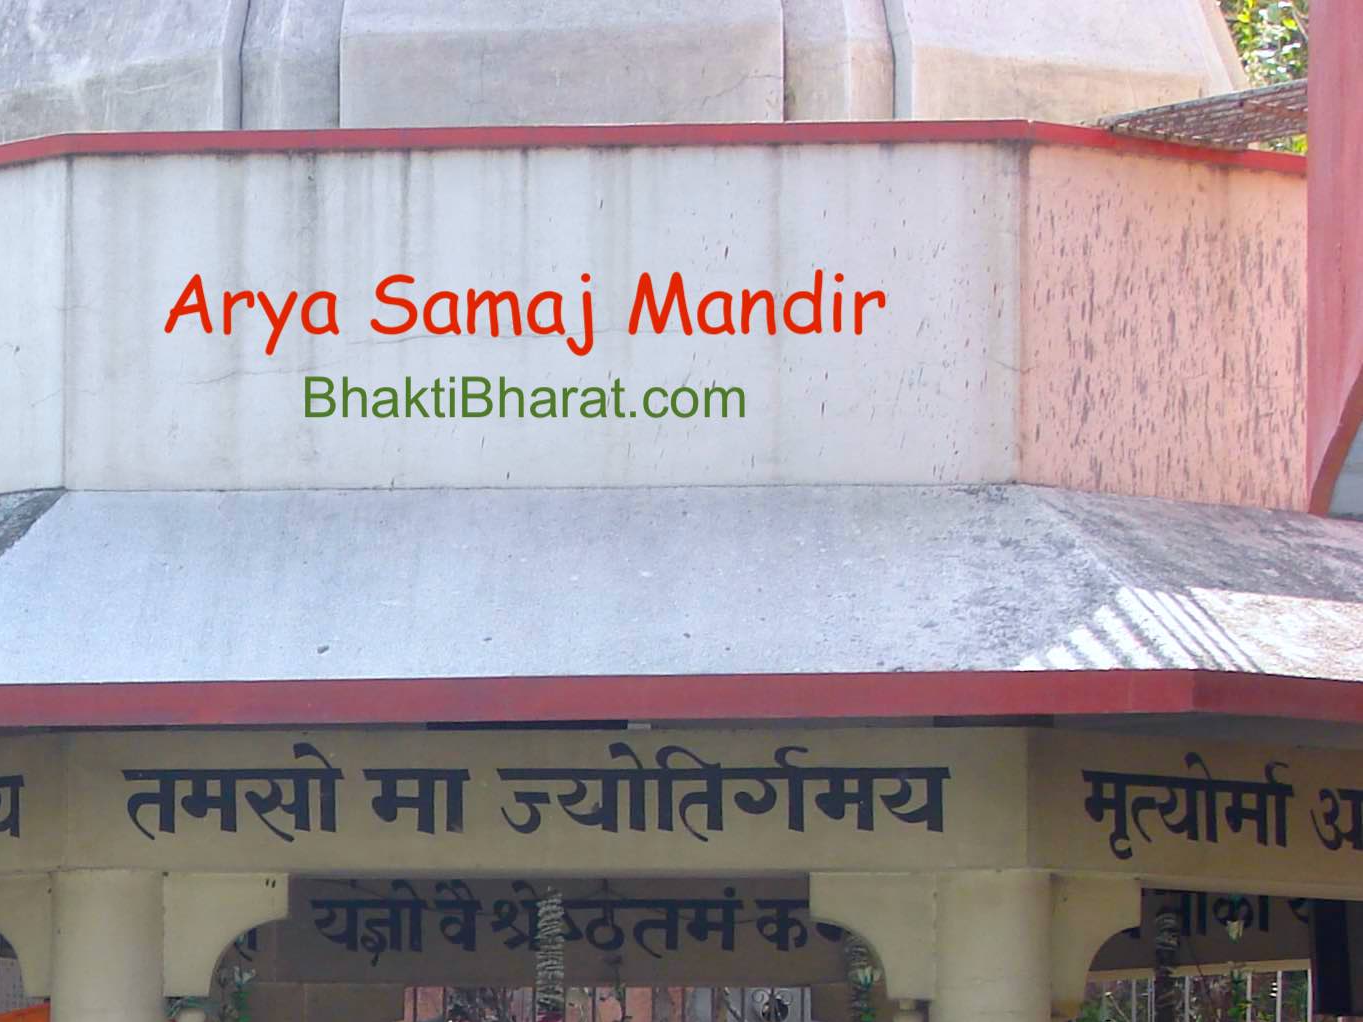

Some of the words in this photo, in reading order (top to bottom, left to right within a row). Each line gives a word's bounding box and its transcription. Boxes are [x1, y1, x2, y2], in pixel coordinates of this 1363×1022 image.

[121, 742, 345, 842] तमसो
[362, 767, 472, 835] मा
[496, 742, 952, 843] ज्योतिर्गमय
[1081, 751, 1296, 860] मृत्योर्मा
